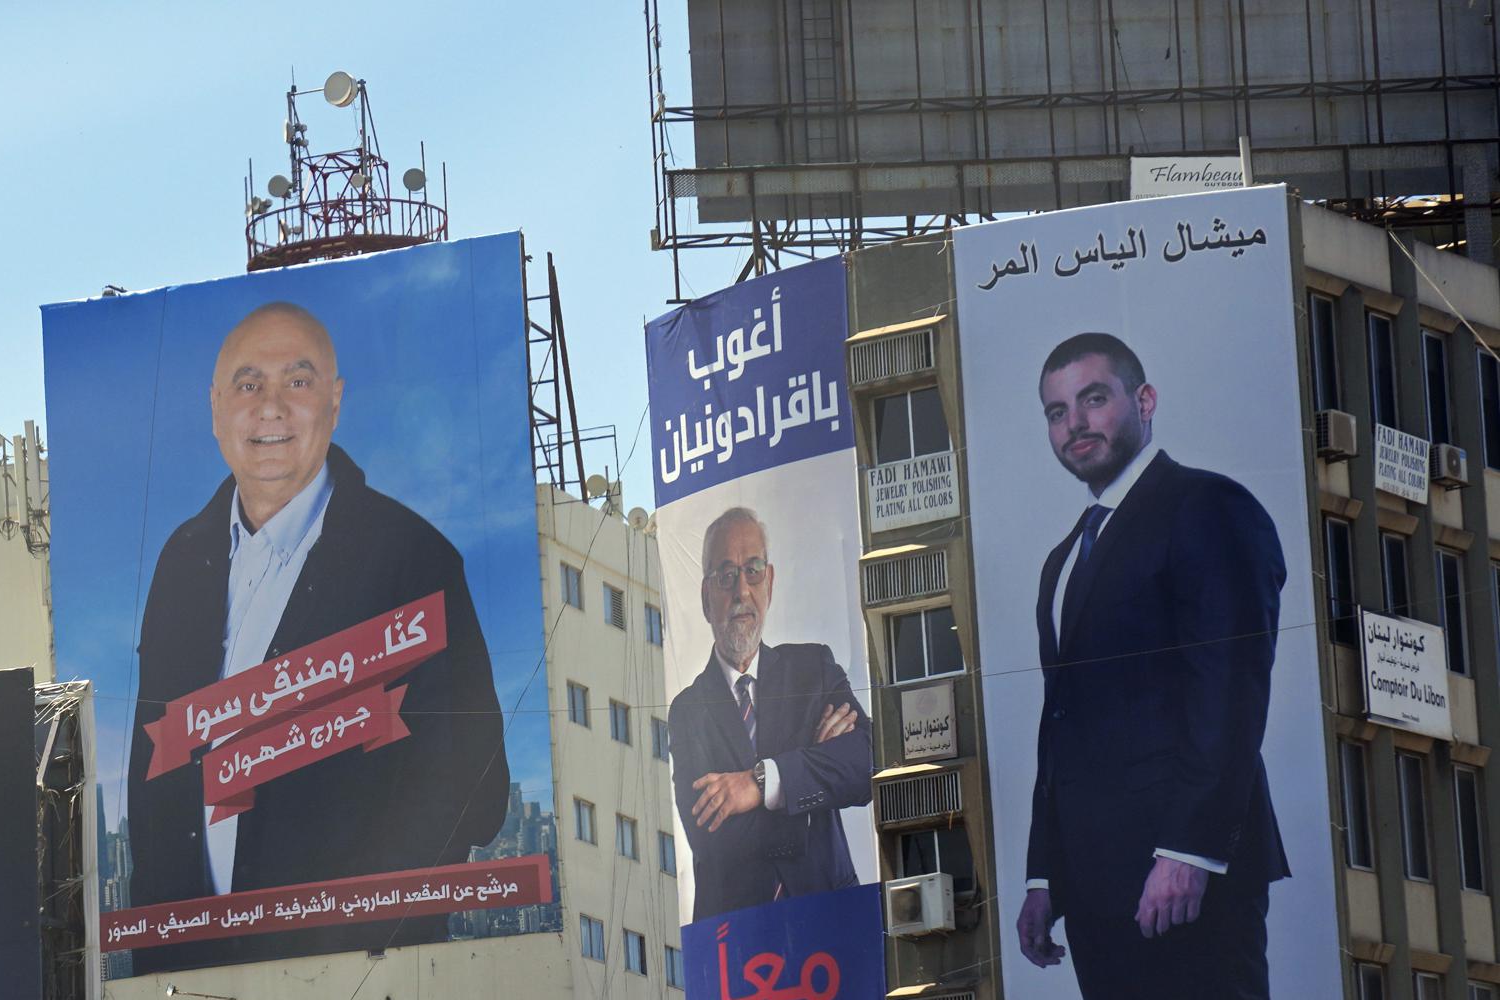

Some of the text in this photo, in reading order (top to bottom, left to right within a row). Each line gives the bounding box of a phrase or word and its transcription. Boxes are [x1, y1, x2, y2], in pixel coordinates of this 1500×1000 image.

[977, 216, 1268, 290] ميشال الياس المر
[687, 286, 783, 390] أغوب
[659, 370, 840, 485] باقرادونيان
[1377, 426, 1395, 447] FADI
[870, 455, 952, 487] FADI HAMAWI
[876, 474, 952, 502] JEWELRY POLISHING
[876, 491, 953, 519] PLATING ALL COLORS
[1368, 622, 1391, 648] لبنان
[1370, 670, 1446, 709] Comptoir Du Liban
[186, 695, 242, 741] سوا
[905, 720, 922, 742] لبنان
[217, 704, 371, 785] جورج شهوان
[274, 891, 336, 920] الأشرفية
[403, 883, 450, 903] المقعد
[452, 884, 475, 902] عن
[156, 911, 210, 939] الصيفي
[220, 904, 264, 928] الرميل
